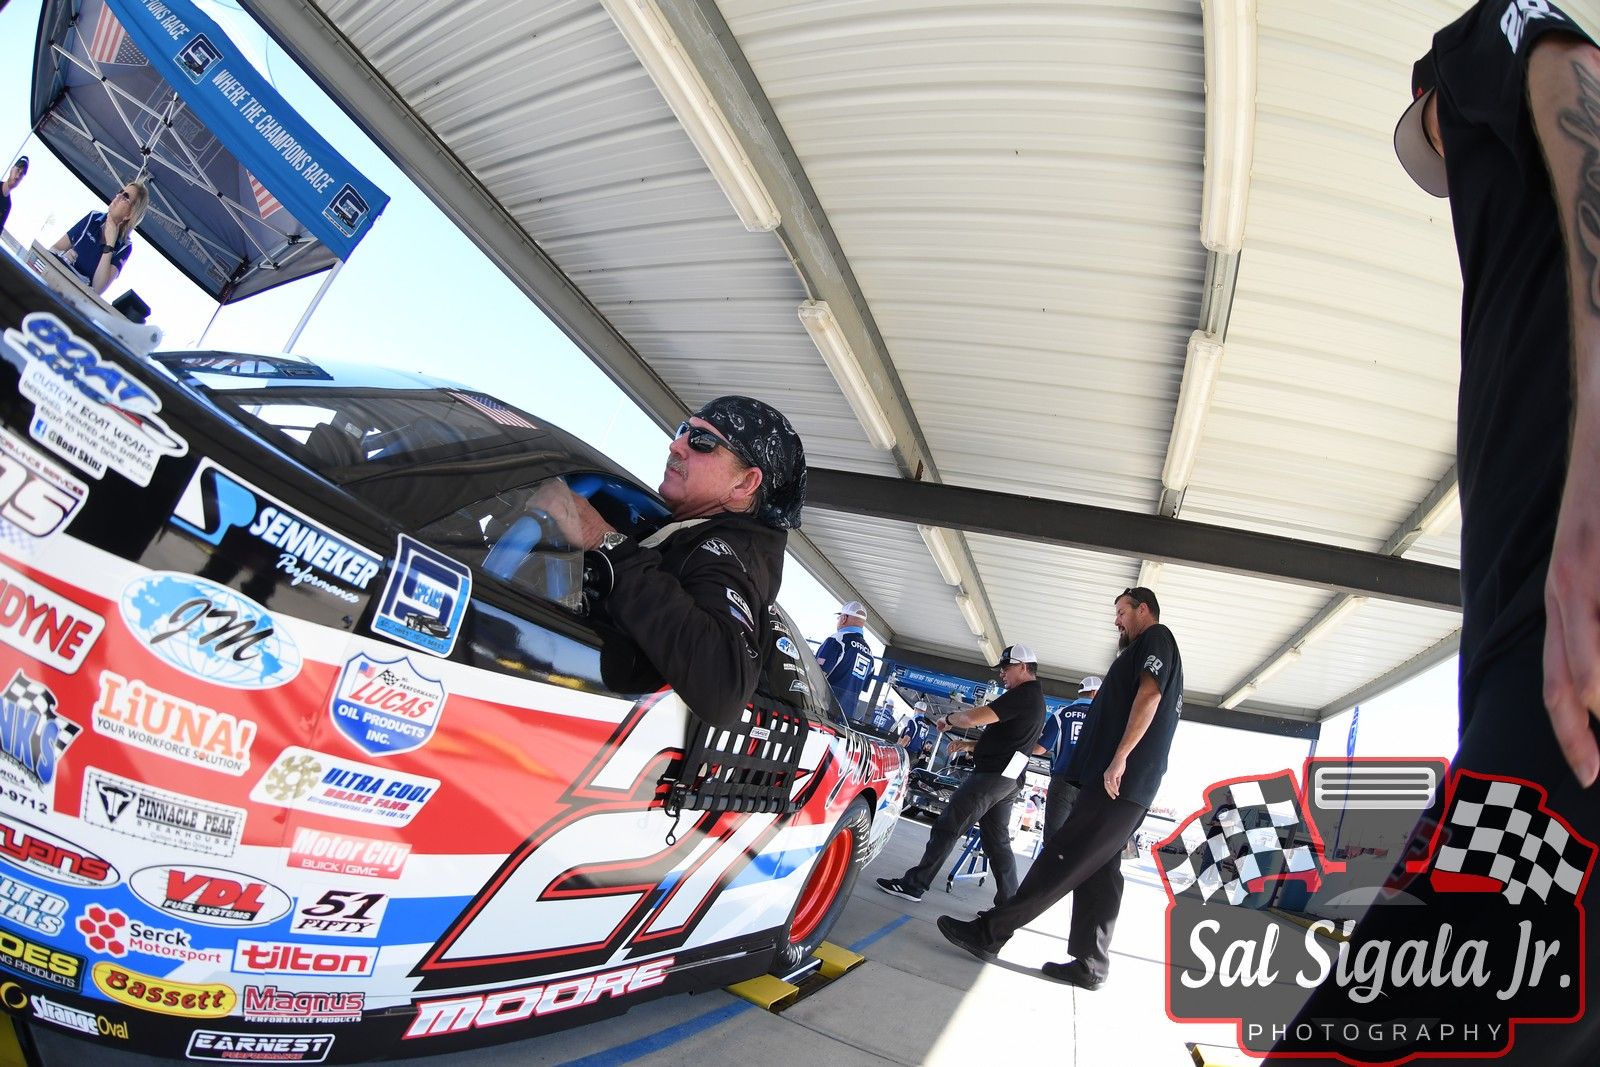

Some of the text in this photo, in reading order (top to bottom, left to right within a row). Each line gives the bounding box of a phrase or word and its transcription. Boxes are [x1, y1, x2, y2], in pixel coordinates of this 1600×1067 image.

[142, 0, 190, 40] IONS RACE
[212, 69, 335, 194] WHERE THE CHAMPIONS RACE
[78, 449, 102, 472] Skinz
[249, 506, 380, 589] SENNEKER
[277, 552, 360, 603] Performance
[348, 681, 434, 718] LUCAS
[399, 683, 439, 700] PERFORMANCE
[98, 677, 252, 760] LiUNA!
[338, 703, 426, 738] OIL PRODUCTS
[97, 717, 243, 771] YOUR WORKFORCE SOLUTION
[365, 729, 390, 745] INC.
[0, 785, 48, 815] -9712
[321, 767, 432, 803] ULTRA COOL
[323, 788, 374, 805] BRAKE
[373, 798, 410, 812] FANS
[137, 797, 236, 836] PINNACLE PEAK
[136, 820, 229, 846] STEAKHOUSE
[293, 828, 413, 873] Motor City
[302, 859, 381, 877] BUICK GMC
[165, 869, 267, 913] VDL
[301, 890, 386, 920] 51
[163, 899, 252, 921] FUEL SYSTEMS
[130, 923, 188, 947] Serck
[294, 918, 374, 934] FIFTY
[129, 938, 222, 963] Motorsport
[242, 944, 369, 973] tilton
[15, 961, 76, 988] PRODUCTS
[106, 969, 226, 1010] Bassett
[244, 985, 364, 1016] Magnus
[402, 956, 677, 1039] MOORE
[244, 1015, 362, 1024] PERFORMANCE PRODUCTS
[194, 1034, 328, 1052] EARNEST
[222, 1051, 304, 1060] PERFORMANCE
